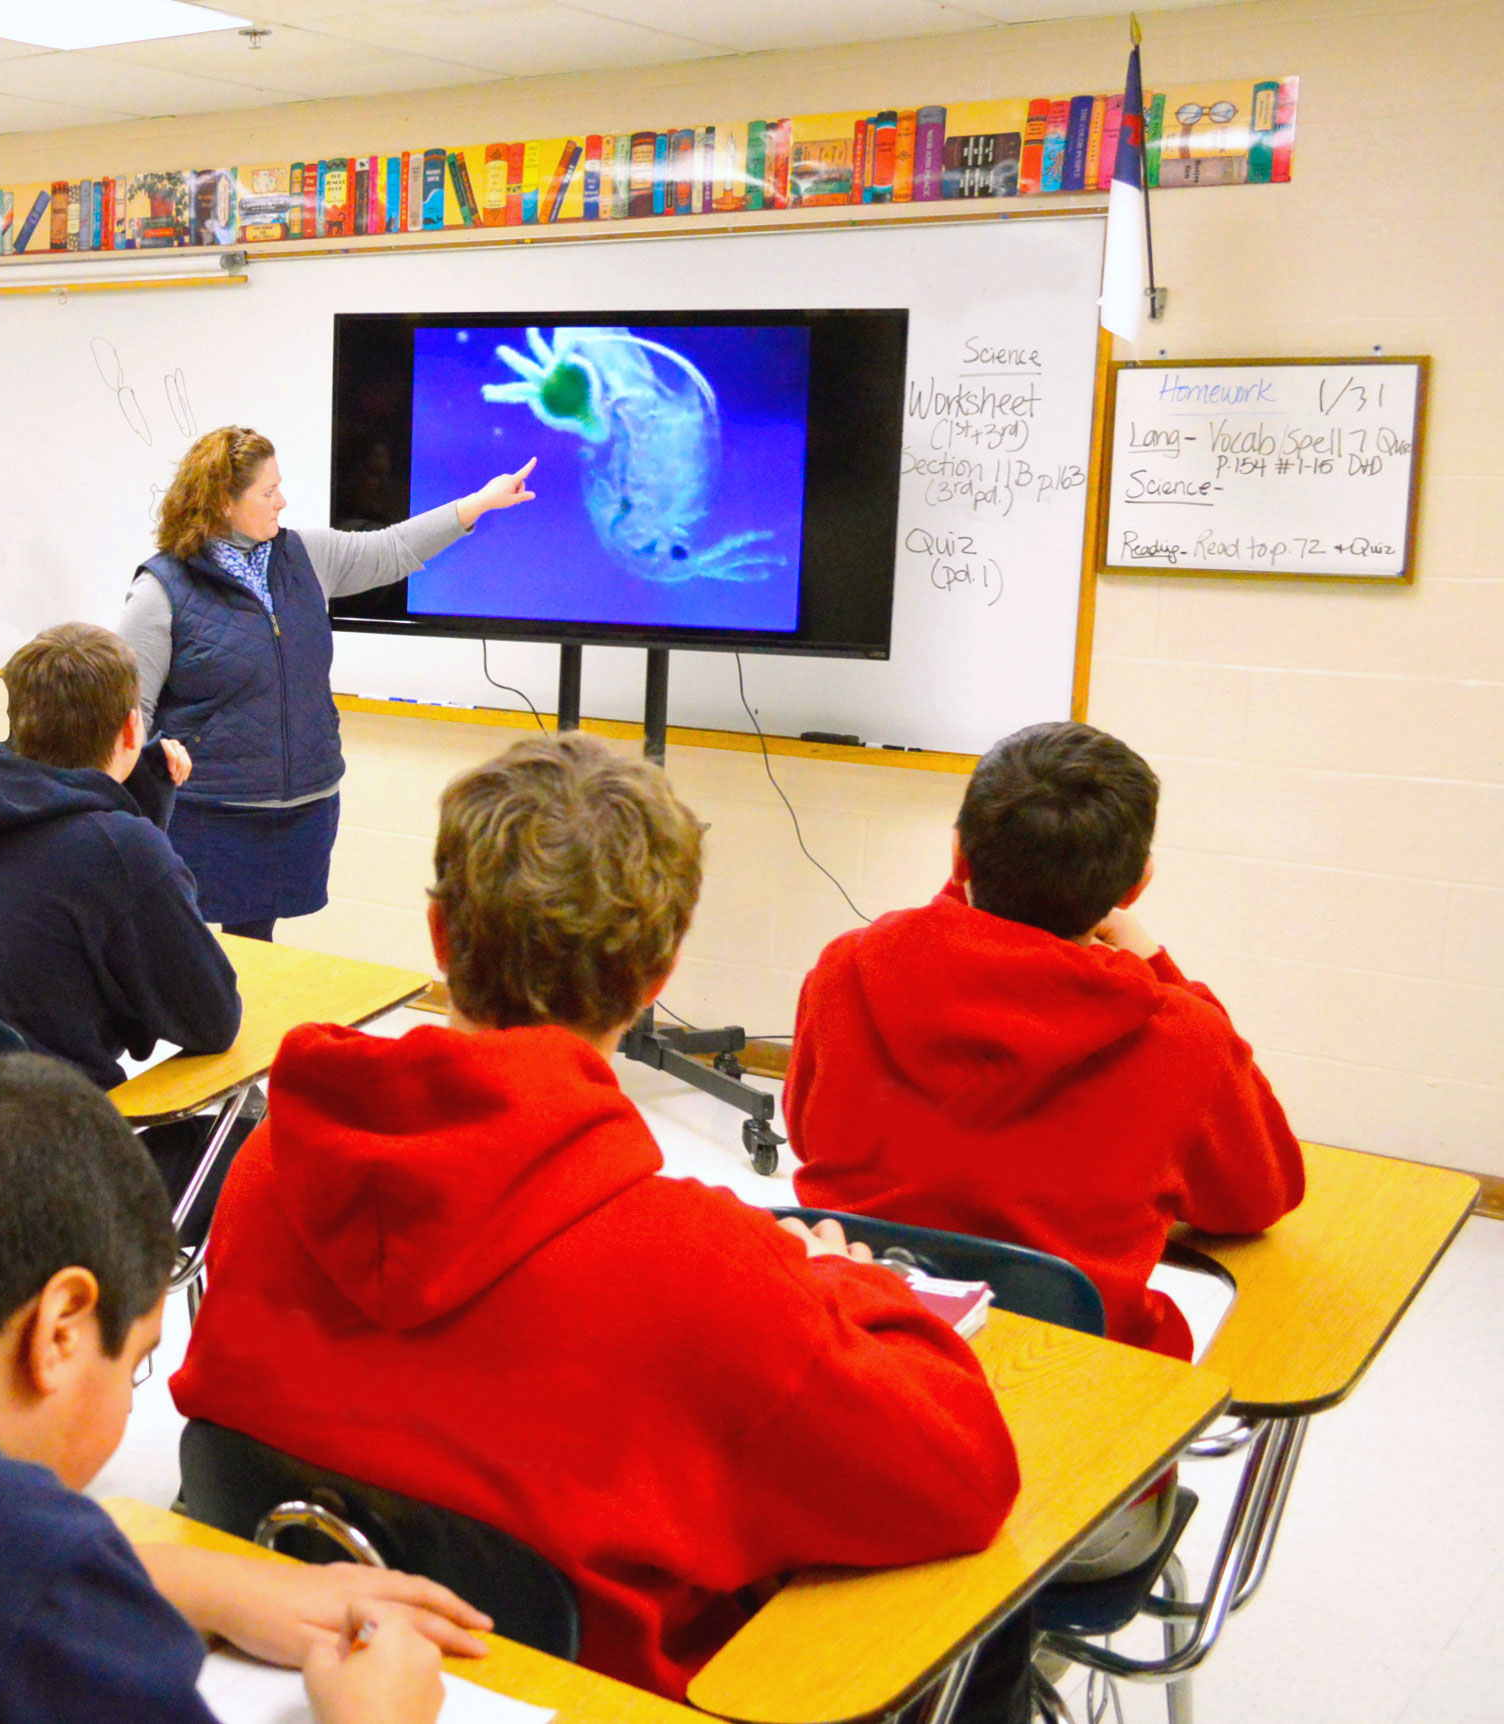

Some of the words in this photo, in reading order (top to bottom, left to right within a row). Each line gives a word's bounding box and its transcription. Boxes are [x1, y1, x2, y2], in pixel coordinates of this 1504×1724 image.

[963, 336, 1042, 367] Science
[909, 376, 1042, 420] Worksheet
[1159, 374, 1276, 405] Homework
[1318, 377, 1384, 415] 1/31
[901, 445, 983, 482] Section
[905, 528, 977, 557] Quiz
[1193, 529, 1240, 560] Read
